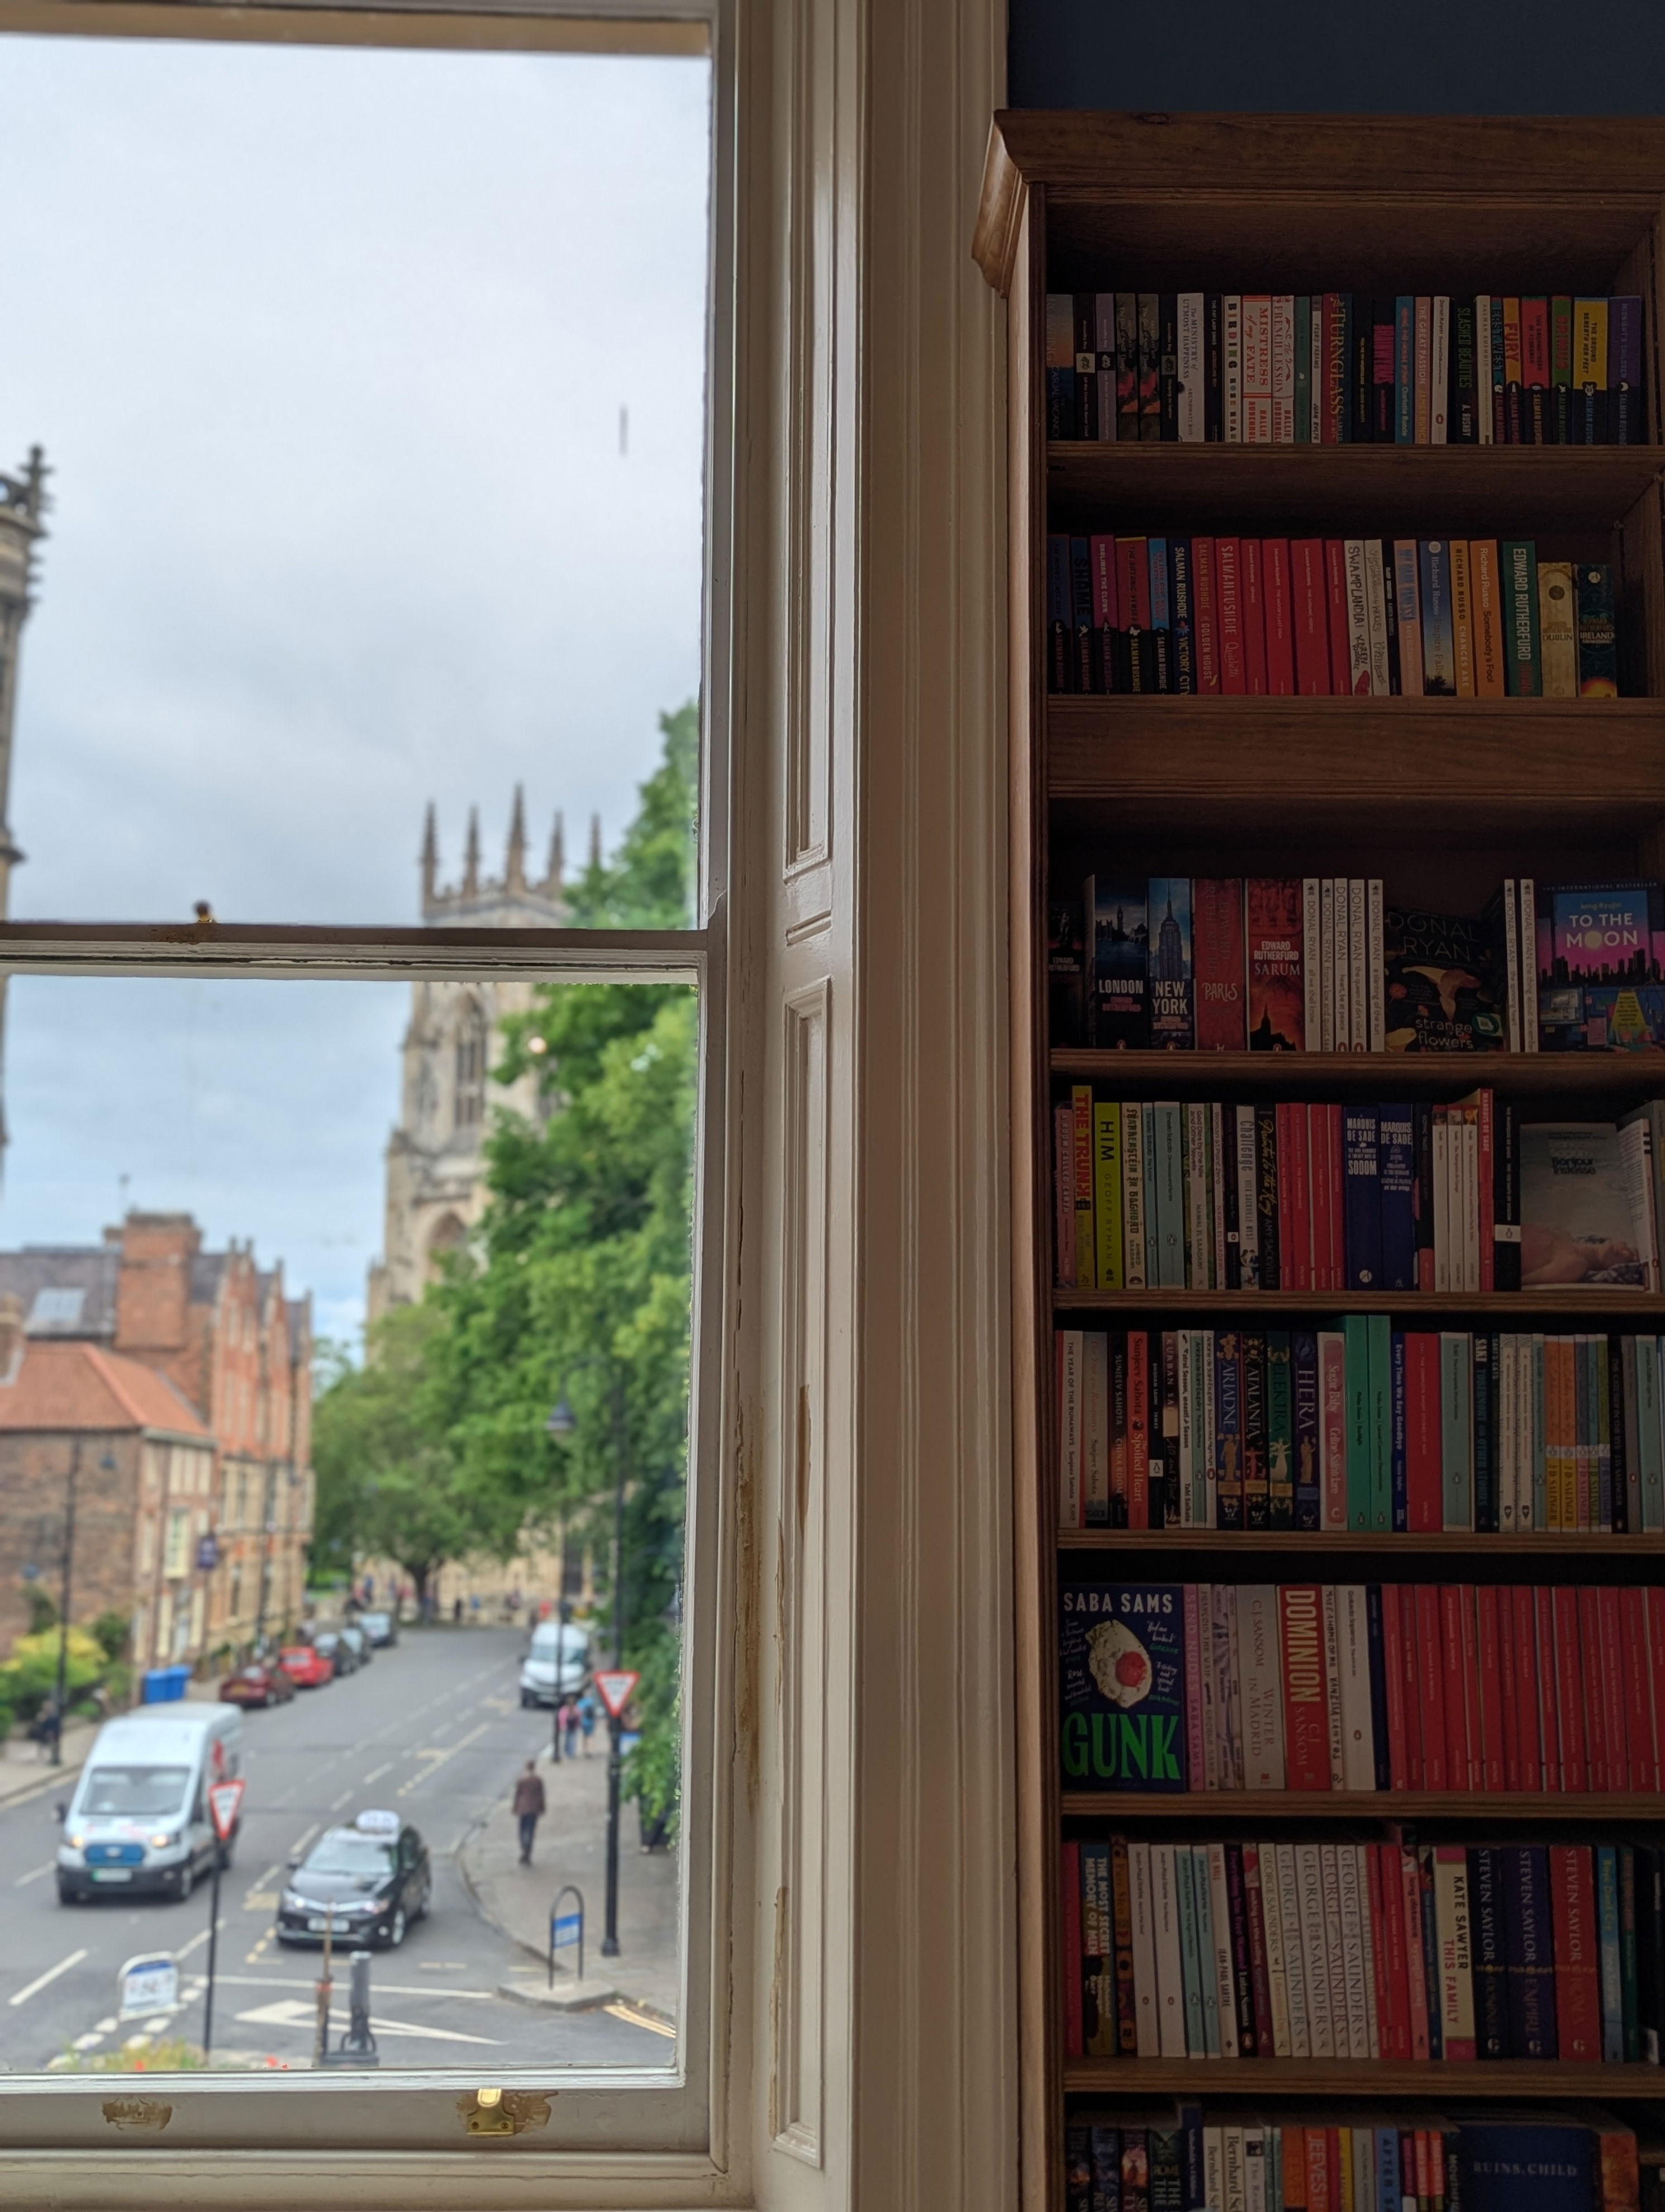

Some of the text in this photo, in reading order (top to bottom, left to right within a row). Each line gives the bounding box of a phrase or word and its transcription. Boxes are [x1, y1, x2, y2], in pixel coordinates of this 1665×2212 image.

[1245, 326, 1254, 338] my
[1247, 315, 1257, 325] of
[1259, 307, 1268, 386] MISTRESS
[1274, 306, 1283, 393] FRENCH LESSON
[1330, 308, 1346, 414] TURNGLASS
[1505, 323, 1519, 362] FURY
[1174, 547, 1184, 581] SALMAN
[1431, 557, 1440, 588] Richard
[1456, 549, 1464, 587] RICHARD
[1480, 548, 1488, 580] Richard
[1073, 558, 1090, 615] SHAME
[1176, 583, 1187, 618] RUSHDIE
[1513, 549, 1531, 659] EDWARD RUTHERFURD
[1198, 544, 1212, 680] SALMAN RUSHDIE GOLDEN HOUSE
[1178, 637, 1188, 673] VICTORY
[1355, 634, 1368, 664] KAREN
[1433, 619, 1443, 651] Empire
[1483, 611, 1493, 662] Somebody's
[1385, 912, 1480, 942] DONAL
[1569, 913, 1633, 927] TO THE
[1254, 951, 1298, 960] RUTHERFURD
[1262, 941, 1291, 950] EDWARD
[1404, 936, 1471, 962] RYAN
[1098, 979, 1143, 994] LONDON
[1155, 981, 1184, 996] NEW
[1255, 963, 1300, 975] SARUM
[1372, 974, 1380, 1000] slanting
[1153, 999, 1188, 1014] YORK
[1202, 983, 1238, 1001] PARIS
[1415, 1019, 1472, 1036] strange
[1418, 1032, 1473, 1048] flowers
[1101, 1121, 1114, 1161] HIM
[1347, 1118, 1376, 1129] MARQUIS
[1347, 1130, 1376, 1142] DE SADE
[1381, 1122, 1411, 1133] MARQUIS
[1381, 1133, 1411, 1145] DE SADE
[1196, 1142, 1203, 1150] by
[1348, 1160, 1377, 1175] SODOM
[1264, 1218, 1274, 1285] AMY SACKVILLE
[1068, 1378, 1074, 1387] OF
[1131, 1338, 1143, 1414] Sunjeev Sahota
[1222, 1363, 1236, 1431] ARIADNE
[1273, 1363, 1287, 1431] ELEKTRA
[1396, 1387, 1402, 1399] We
[1247, 1366, 1260, 1439] ATALANTA
[1298, 1370, 1315, 1430] HERA
[1476, 1339, 1487, 1506] SAKI TOBERMORY OTHER STORIES
[1131, 1433, 1143, 1502] Spoiled Heart
[1064, 1592, 1173, 1613] SABA SAMS
[1187, 1595, 1196, 1633] SEND
[1188, 1641, 1197, 1691] NUDES
[1286, 1591, 1321, 1702] DOMINION
[1189, 1698, 1198, 1729] SABA
[1249, 1678, 1261, 1756] IN MADRID
[1263, 1689, 1274, 1745] WINTER
[1062, 1712, 1181, 1779] GUNK
[1295, 1707, 1307, 1765] SANSOM
[1084, 1857, 1097, 1954] MEMORY OF MEN
[1097, 1857, 1110, 1954] THE MOST SECRET
[1454, 1877, 1468, 1969] KATE SAWYER
[1478, 1850, 1494, 1960] STEVEN SAYLOR
[1520, 1851, 1535, 1962] STEVEN SAYLOR
[1566, 1850, 1581, 1961] STEVEN SAYLOR
[1303, 1851, 1328, 2035] GEORGE SAUNDERS
[1323, 1850, 1347, 2033] GEORGE SAUNDERS
[1341, 1849, 1364, 2033] GEORGE SAUNDERS
[1217, 1949, 1230, 2006] JEAN-PAUL SARTRE
[1444, 1939, 1458, 2023] THIS FAMILY
[1208, 2146, 1219, 2192] Bernhard
[1227, 2136, 1241, 2193] Bernhard
[1308, 2137, 1327, 2192] JEEVES
[1383, 2139, 1393, 2187] AFTER
